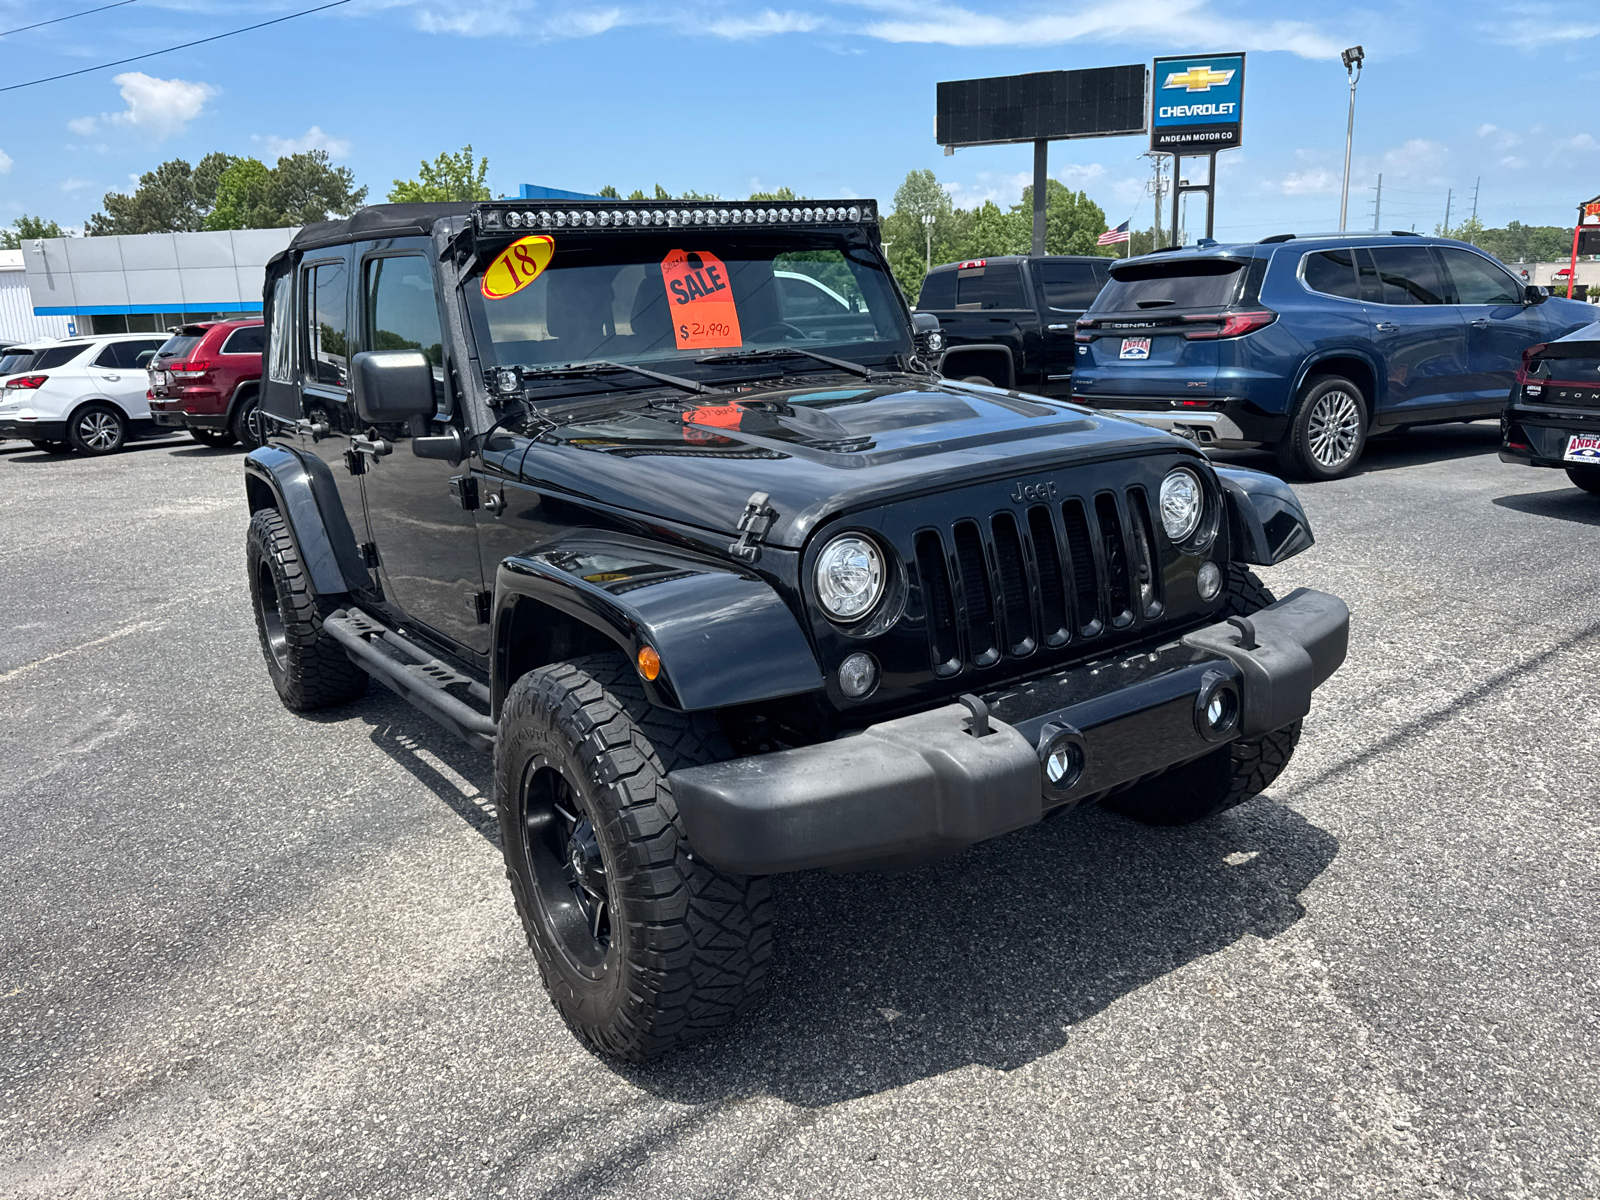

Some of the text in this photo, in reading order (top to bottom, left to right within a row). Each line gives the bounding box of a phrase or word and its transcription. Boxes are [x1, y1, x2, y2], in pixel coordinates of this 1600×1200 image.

[1159, 103, 1236, 117] CHEVROLET
[1160, 134, 1192, 142] ANDEAN
[1193, 133, 1220, 141] MOTOR
[500, 244, 537, 290] 18
[669, 265, 727, 305] SALE
[680, 322, 730, 341] $ 21,990
[1123, 340, 1149, 351] ANDEAN
[1011, 481, 1058, 504] Jeep
